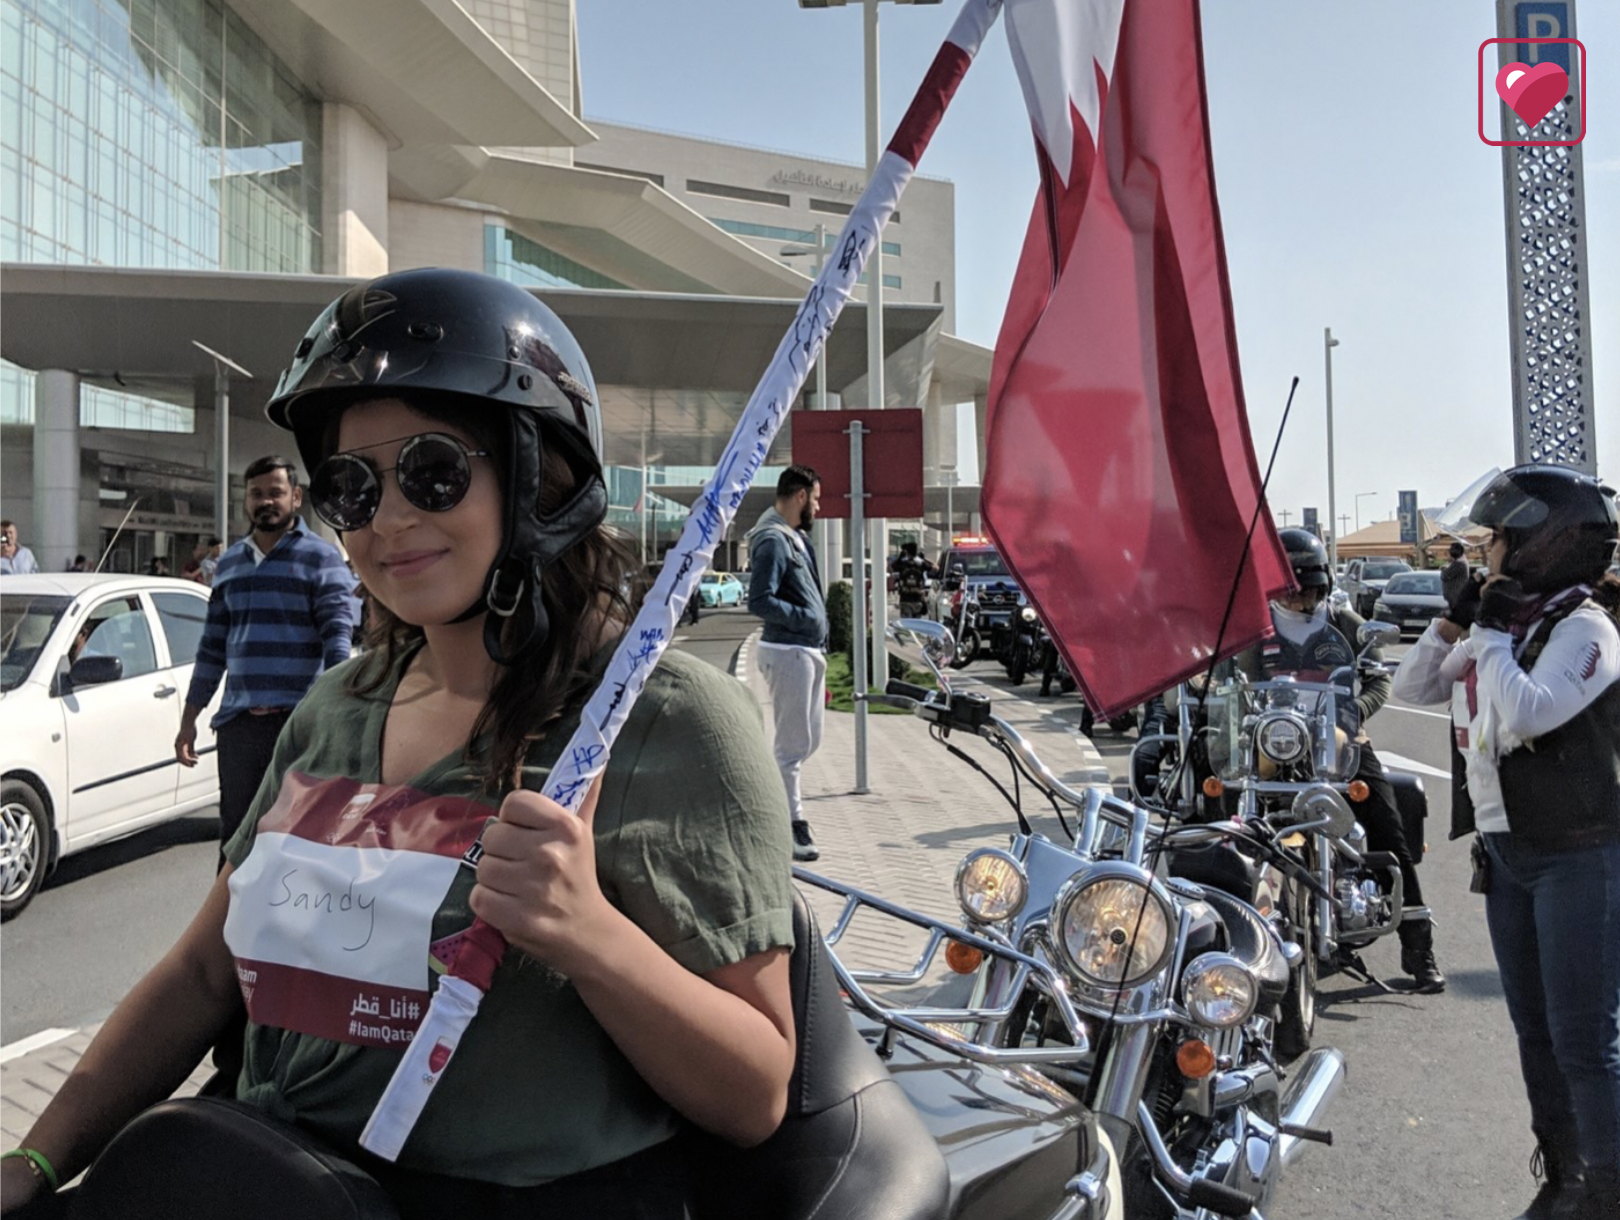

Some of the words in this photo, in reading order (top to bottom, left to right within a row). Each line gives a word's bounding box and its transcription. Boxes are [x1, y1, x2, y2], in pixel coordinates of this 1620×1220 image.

[1527, 13, 1560, 63] P
[268, 868, 377, 951] Sandy
[348, 1018, 415, 1044] #IamQata
